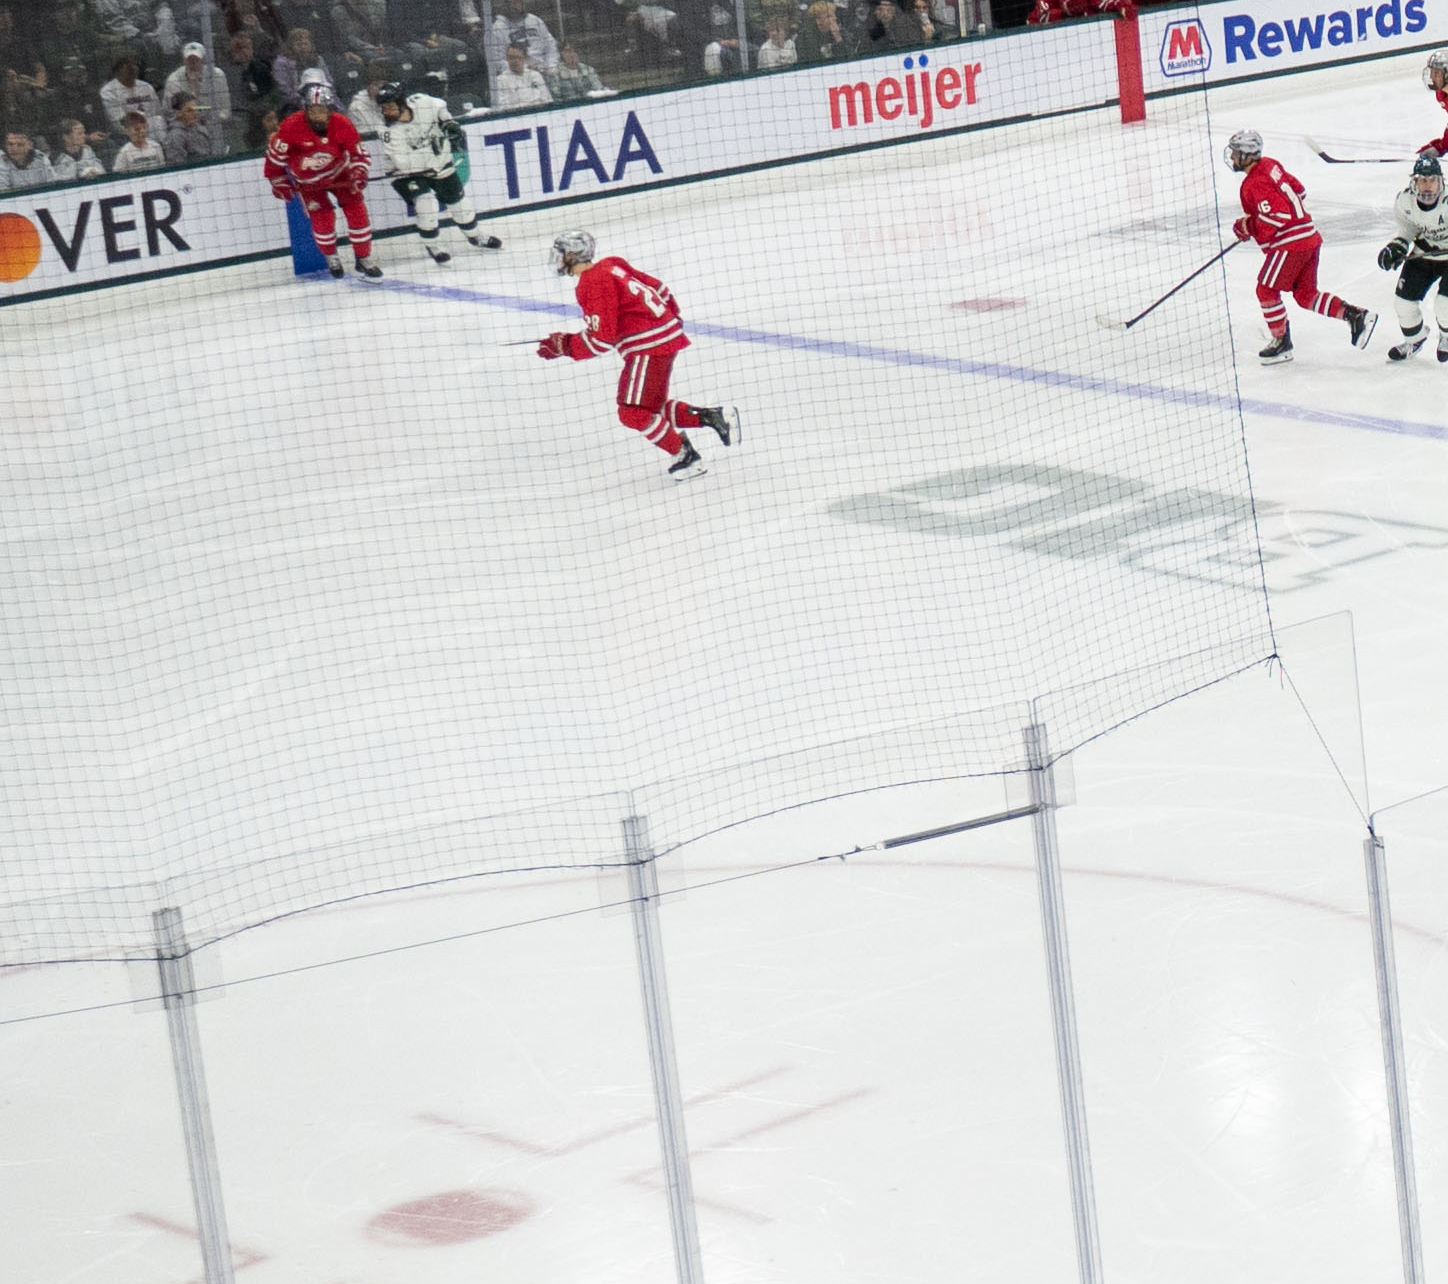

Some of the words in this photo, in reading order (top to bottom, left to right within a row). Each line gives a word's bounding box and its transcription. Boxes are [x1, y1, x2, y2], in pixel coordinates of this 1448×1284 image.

[1166, 56, 1207, 71] Marathon
[1168, 25, 1204, 60] M
[828, 53, 983, 129] meijer
[484, 112, 663, 199] TIAA
